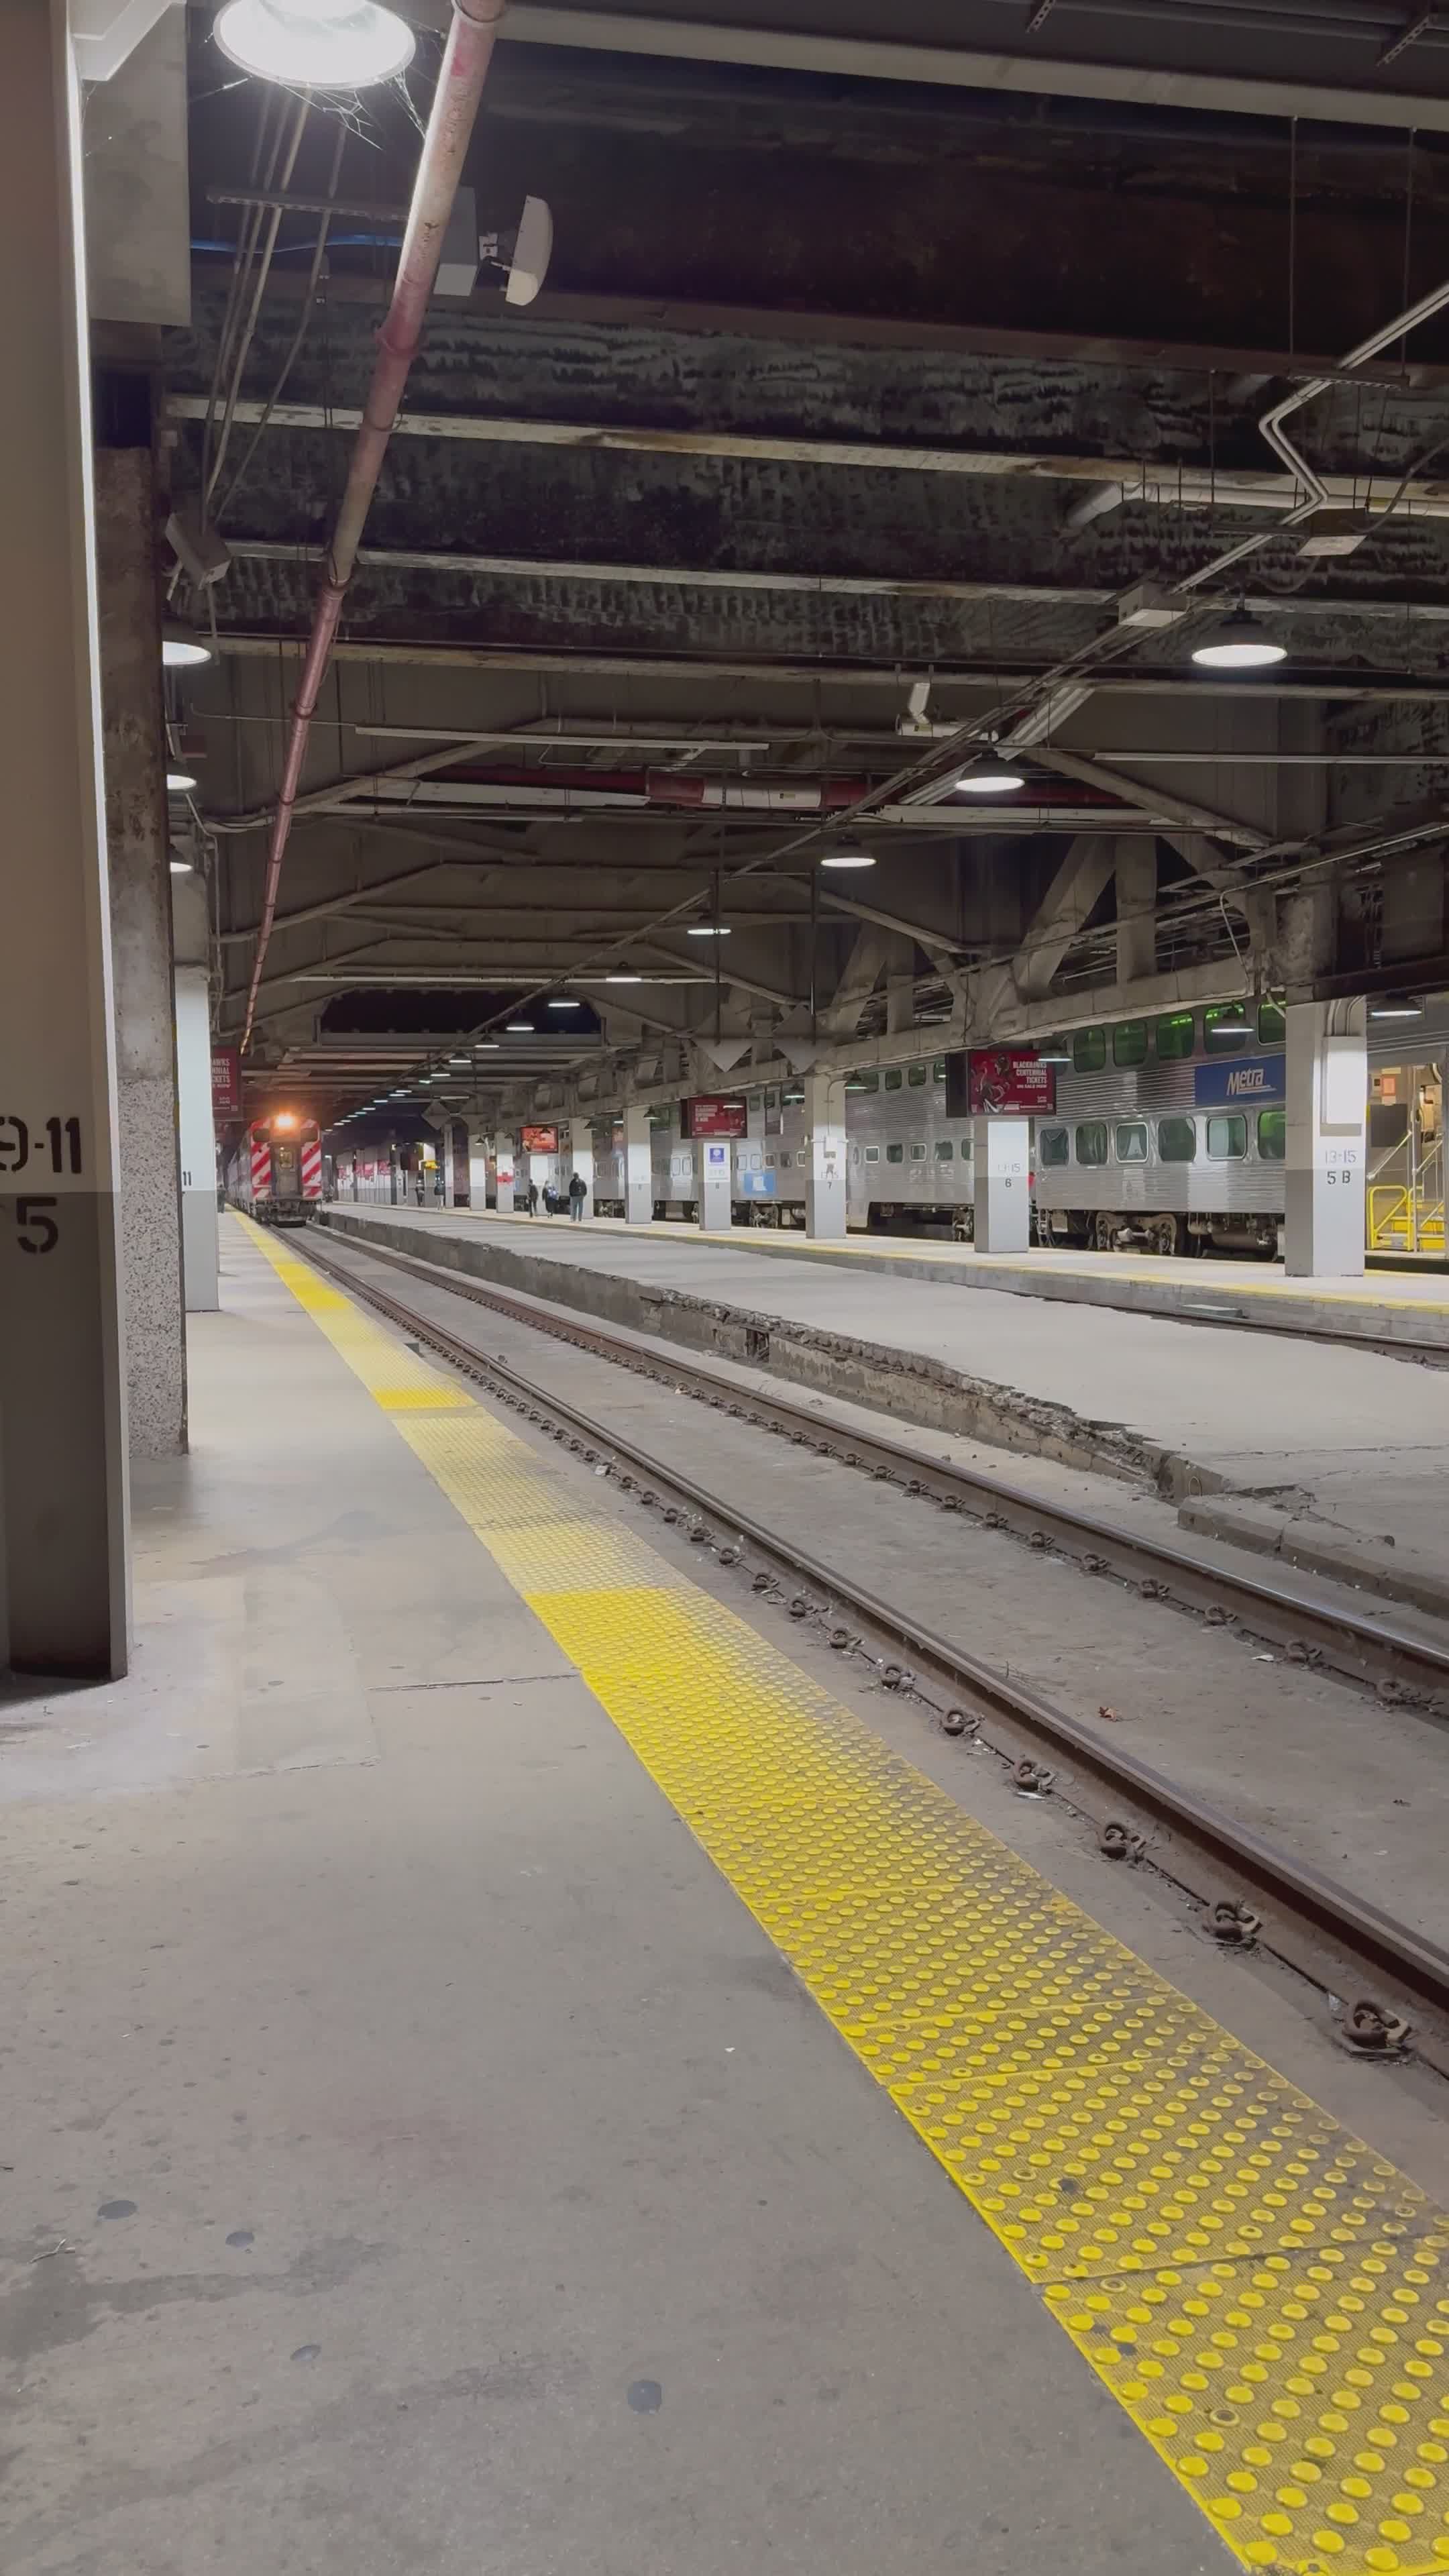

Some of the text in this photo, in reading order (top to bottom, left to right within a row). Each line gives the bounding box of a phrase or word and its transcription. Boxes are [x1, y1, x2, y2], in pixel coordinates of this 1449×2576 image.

[1026, 1076, 1046, 1084] TICKETS
[1226, 1068, 1264, 1095] Metra
[1005, 1178, 1012, 1187] 6
[1327, 1170, 1350, 1185] 5 B
[16, 1196, 58, 1254] 5
